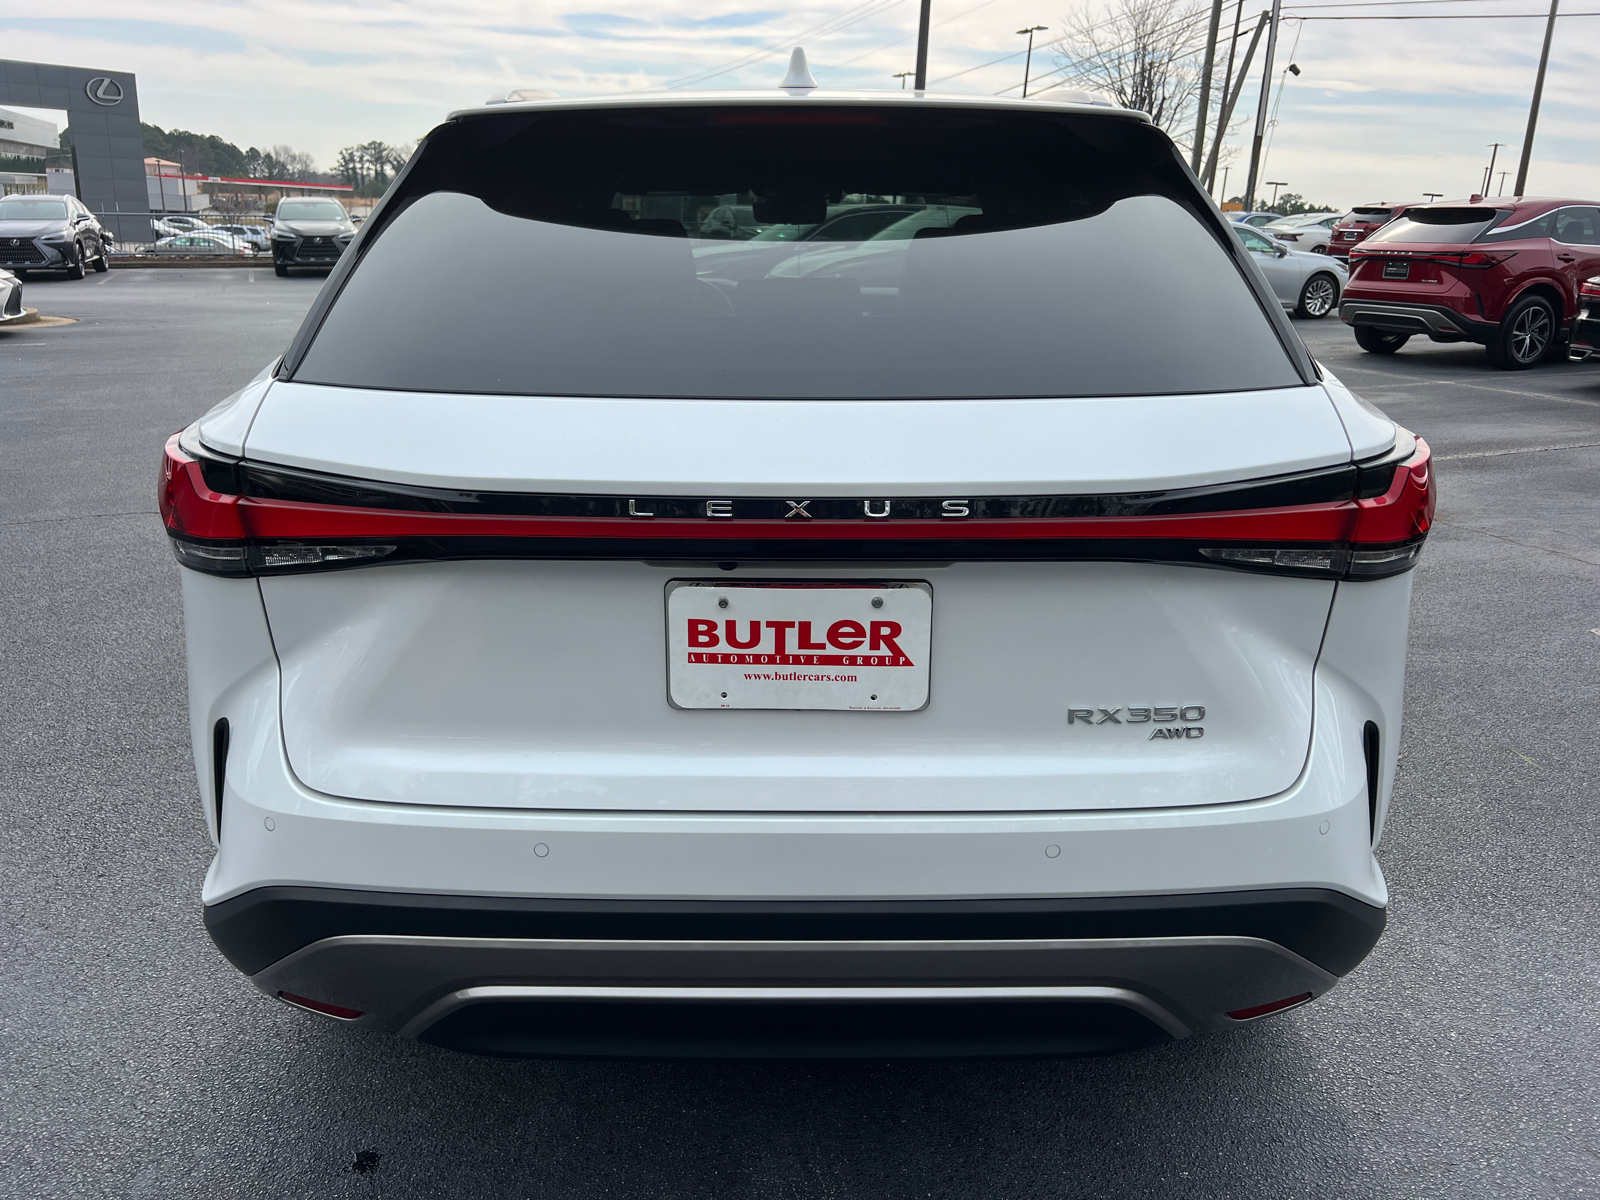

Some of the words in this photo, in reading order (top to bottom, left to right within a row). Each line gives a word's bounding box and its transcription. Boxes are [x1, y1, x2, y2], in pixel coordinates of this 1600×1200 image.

[628, 499, 970, 518] LEXUS
[689, 653, 820, 665] AUTOMOTIVE
[842, 656, 906, 666] GROUP
[743, 671, 858, 683] www.butlercars.com
[1148, 726, 1205, 740] AWD
